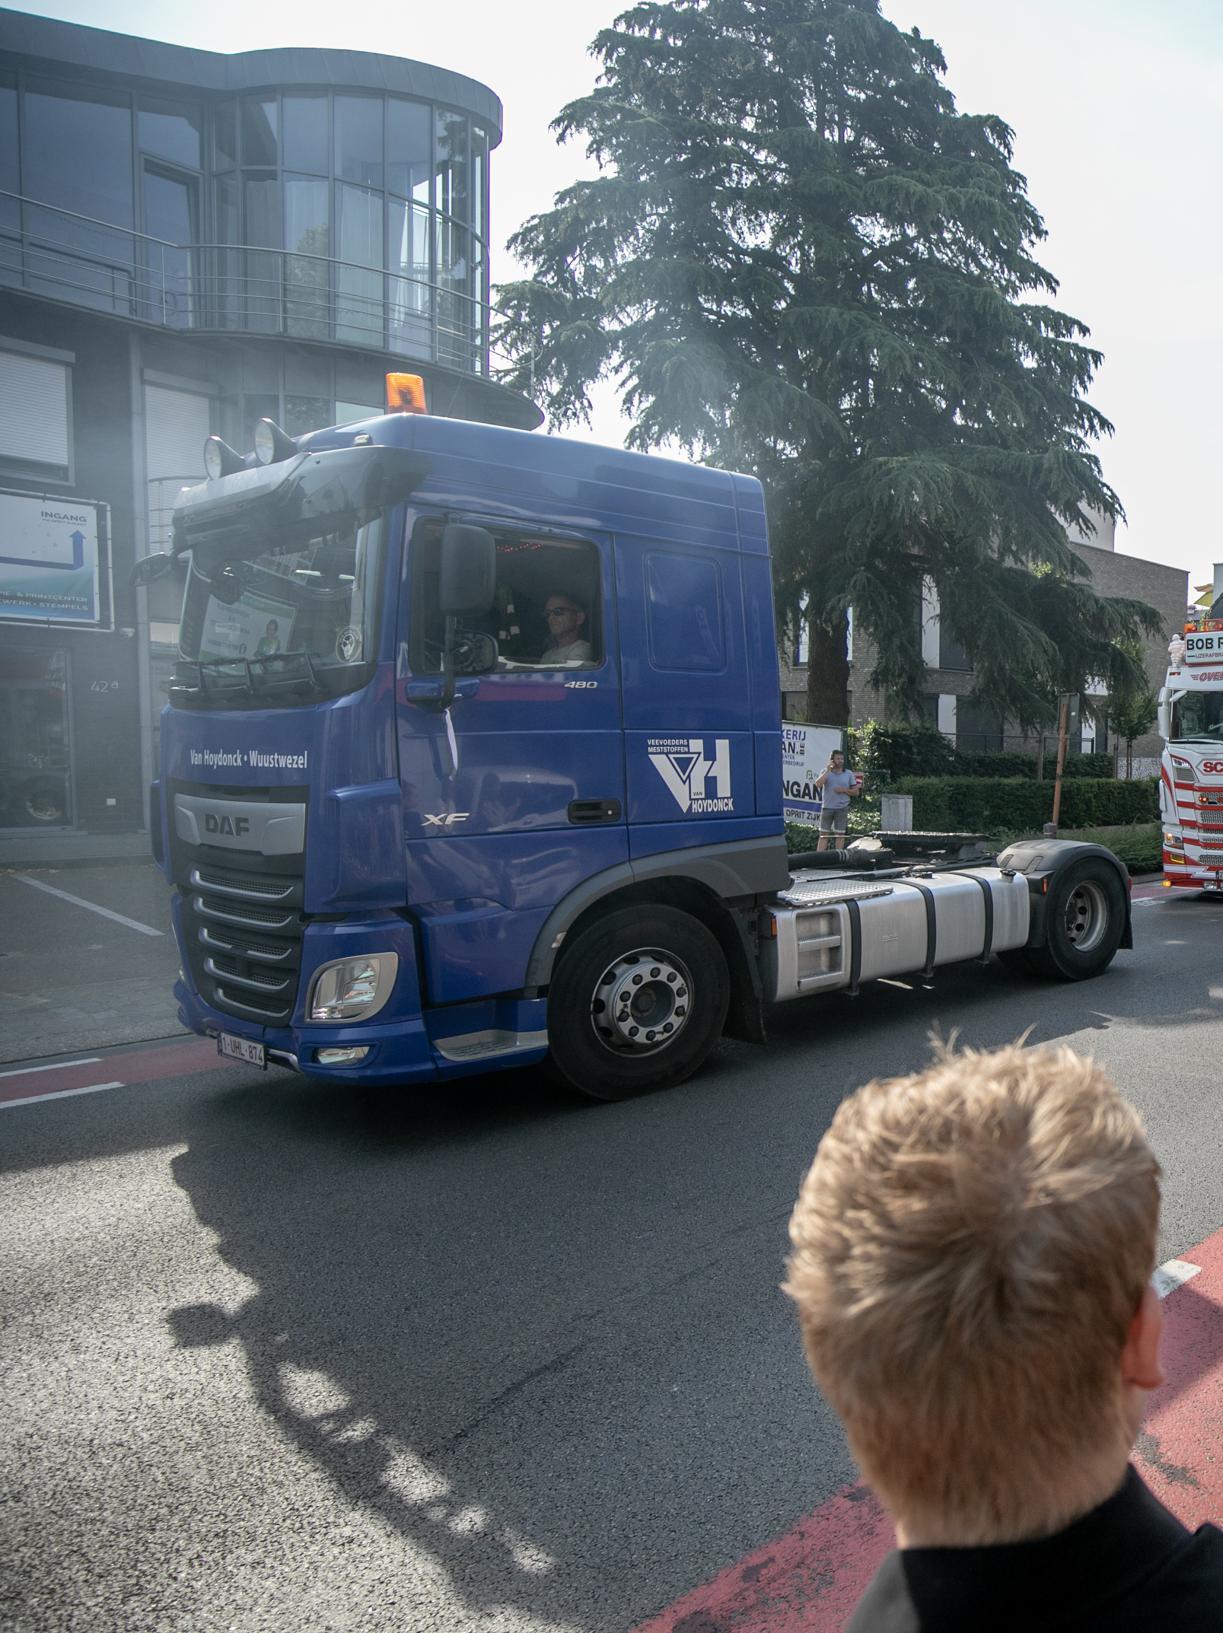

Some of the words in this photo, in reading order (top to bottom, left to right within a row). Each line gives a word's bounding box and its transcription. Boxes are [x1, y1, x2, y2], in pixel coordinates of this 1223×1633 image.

[41, 511, 87, 522] INGANG
[40, 602, 89, 611] STEMPELS
[1187, 638, 1213, 651] BOB
[564, 681, 598, 689] 480
[647, 738, 688, 746] VEEVOEDERS
[647, 745, 689, 753] MESTSTOFFEN
[190, 749, 203, 765] Van
[204, 750, 242, 770] Hoydonck
[249, 750, 308, 769] Wuustwezel
[692, 798, 734, 813] HOYDONCK
[422, 812, 470, 827] XF
[785, 809, 805, 819] OPRIT
[205, 814, 250, 837] DAF
